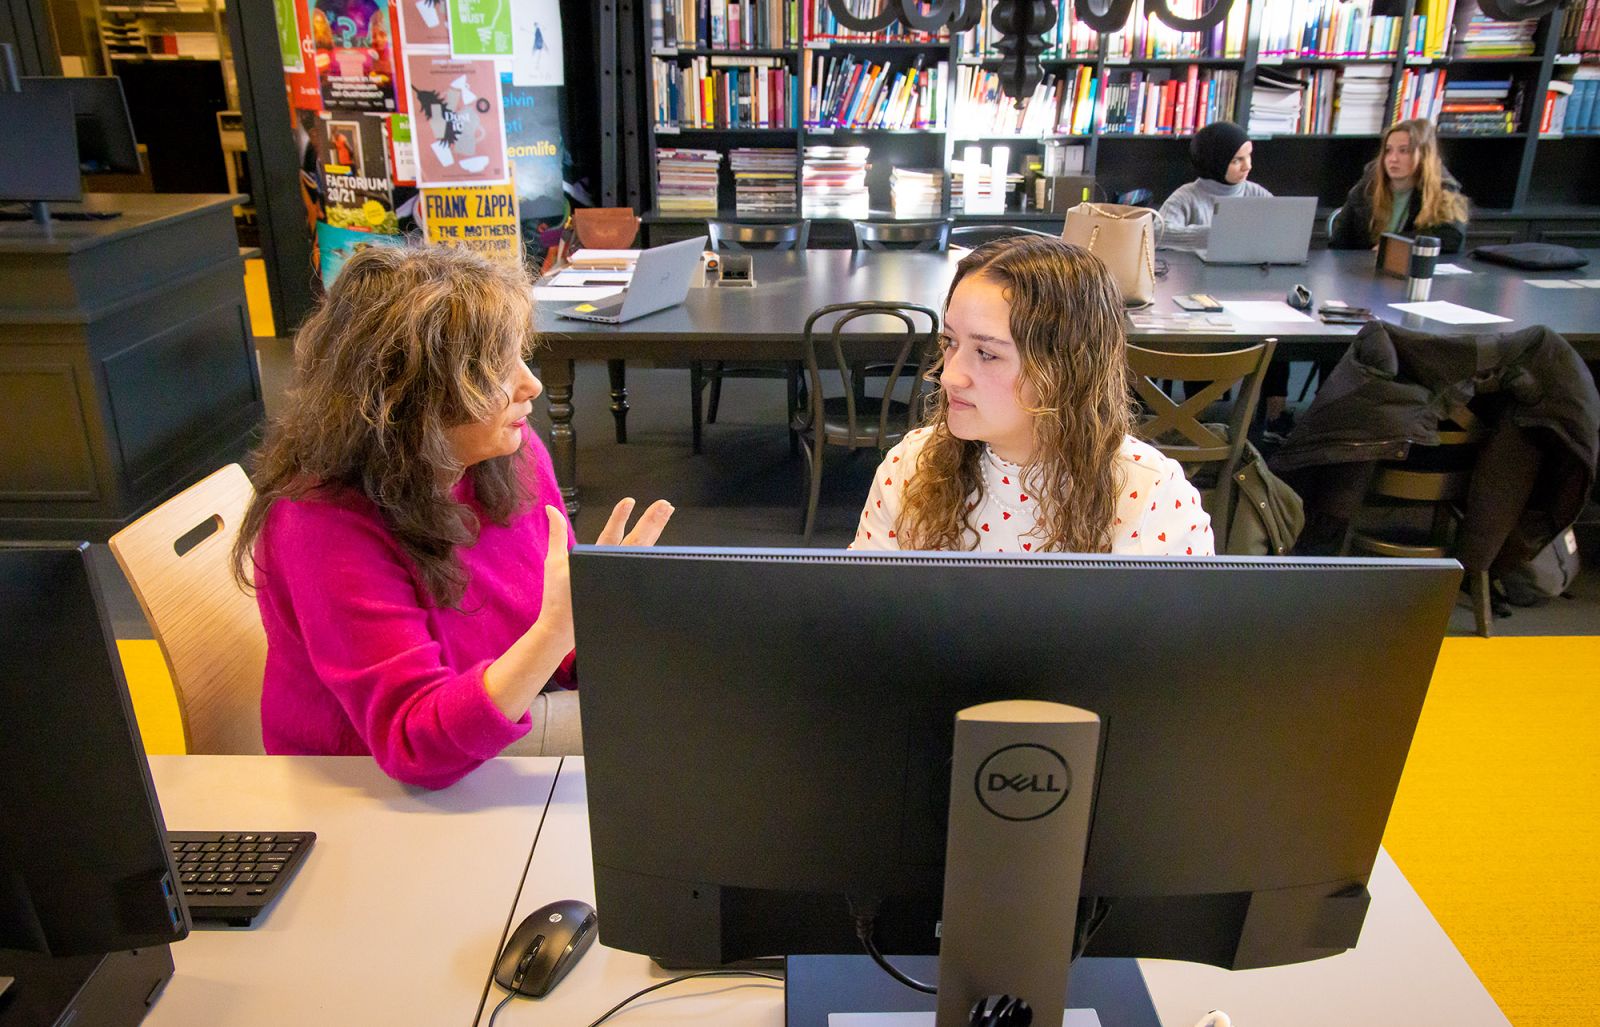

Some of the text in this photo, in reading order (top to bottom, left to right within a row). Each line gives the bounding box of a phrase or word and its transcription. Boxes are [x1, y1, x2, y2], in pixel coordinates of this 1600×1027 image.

[326, 174, 388, 191] FACTORIUM
[328, 188, 356, 203] 20/21
[426, 194, 515, 218] FRANK ZAPPA
[438, 225, 459, 237] THE
[464, 224, 517, 237] MOTHERS
[987, 773, 1061, 792] DELL
